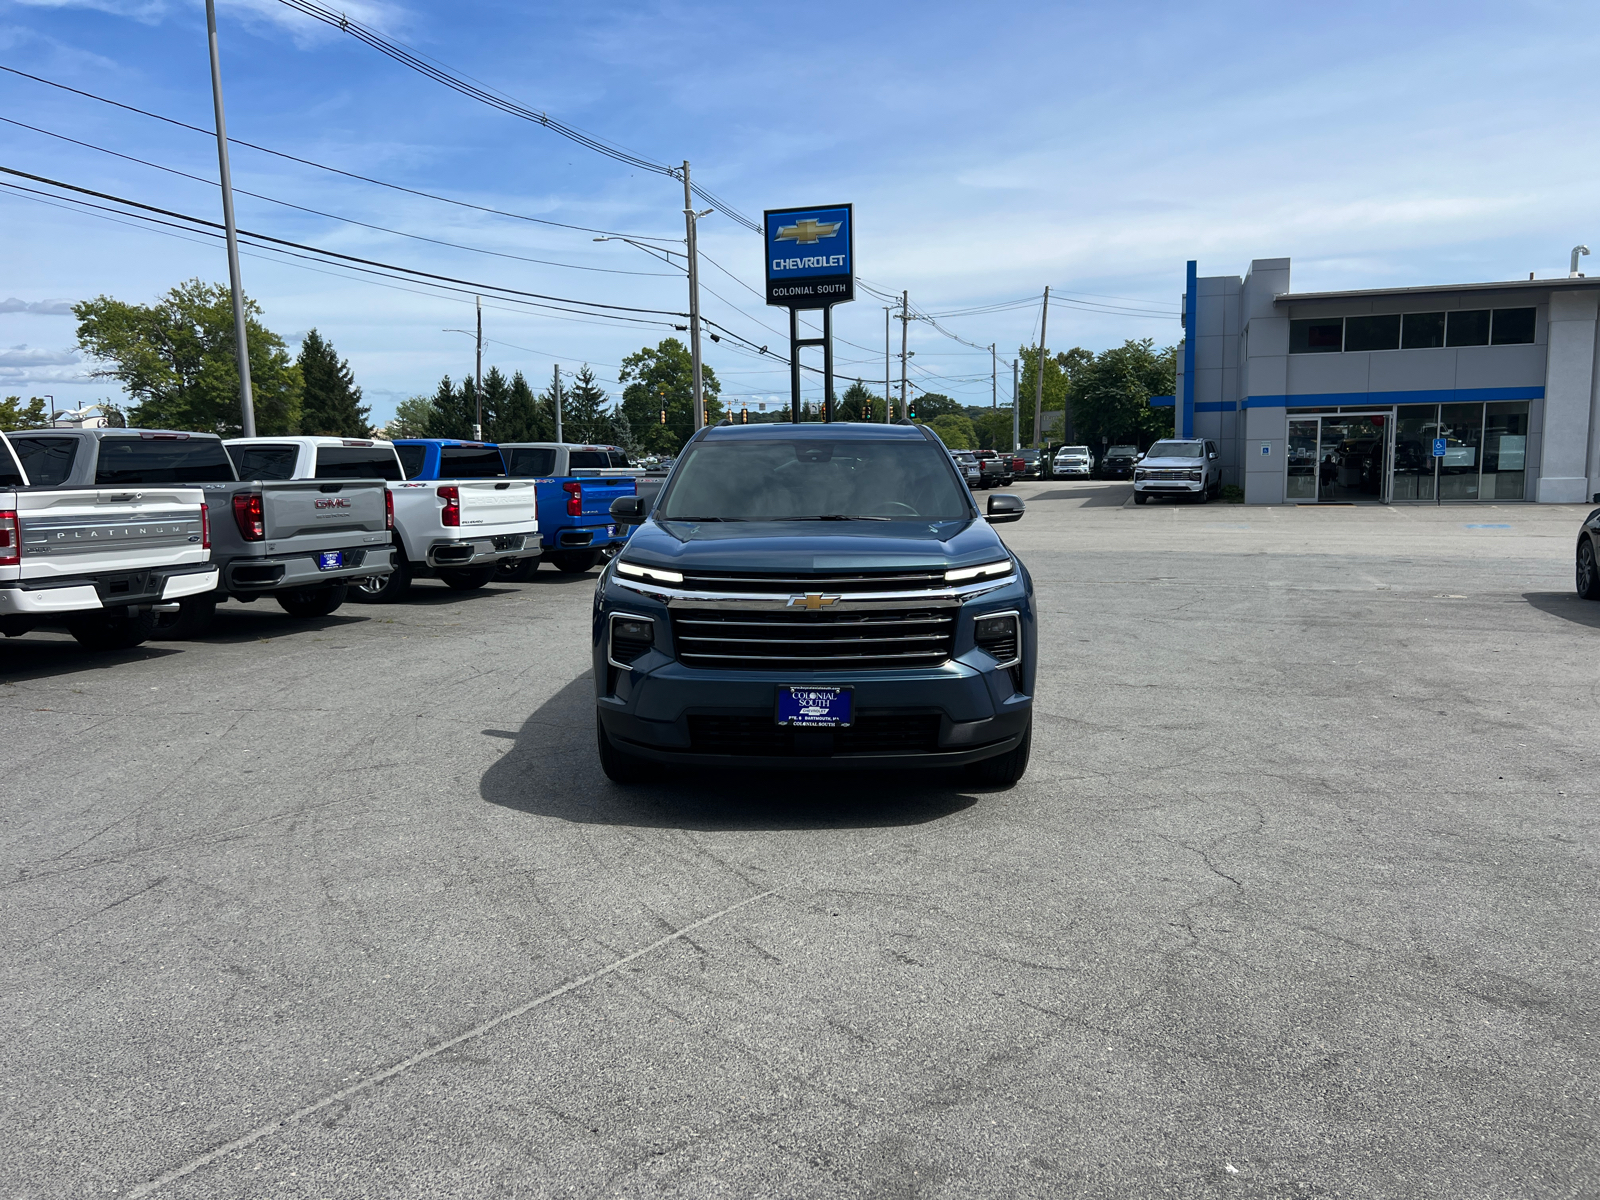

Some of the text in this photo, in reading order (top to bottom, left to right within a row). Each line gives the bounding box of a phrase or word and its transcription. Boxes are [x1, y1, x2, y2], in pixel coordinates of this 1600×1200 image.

[773, 255, 845, 270] CHEVROLET
[773, 284, 846, 296] COLONIAL SOUTH
[315, 497, 351, 509] GMC
[467, 495, 533, 505] CHEVROLET
[56, 526, 181, 539] PLATINUM
[792, 692, 837, 700] COLONIAL
